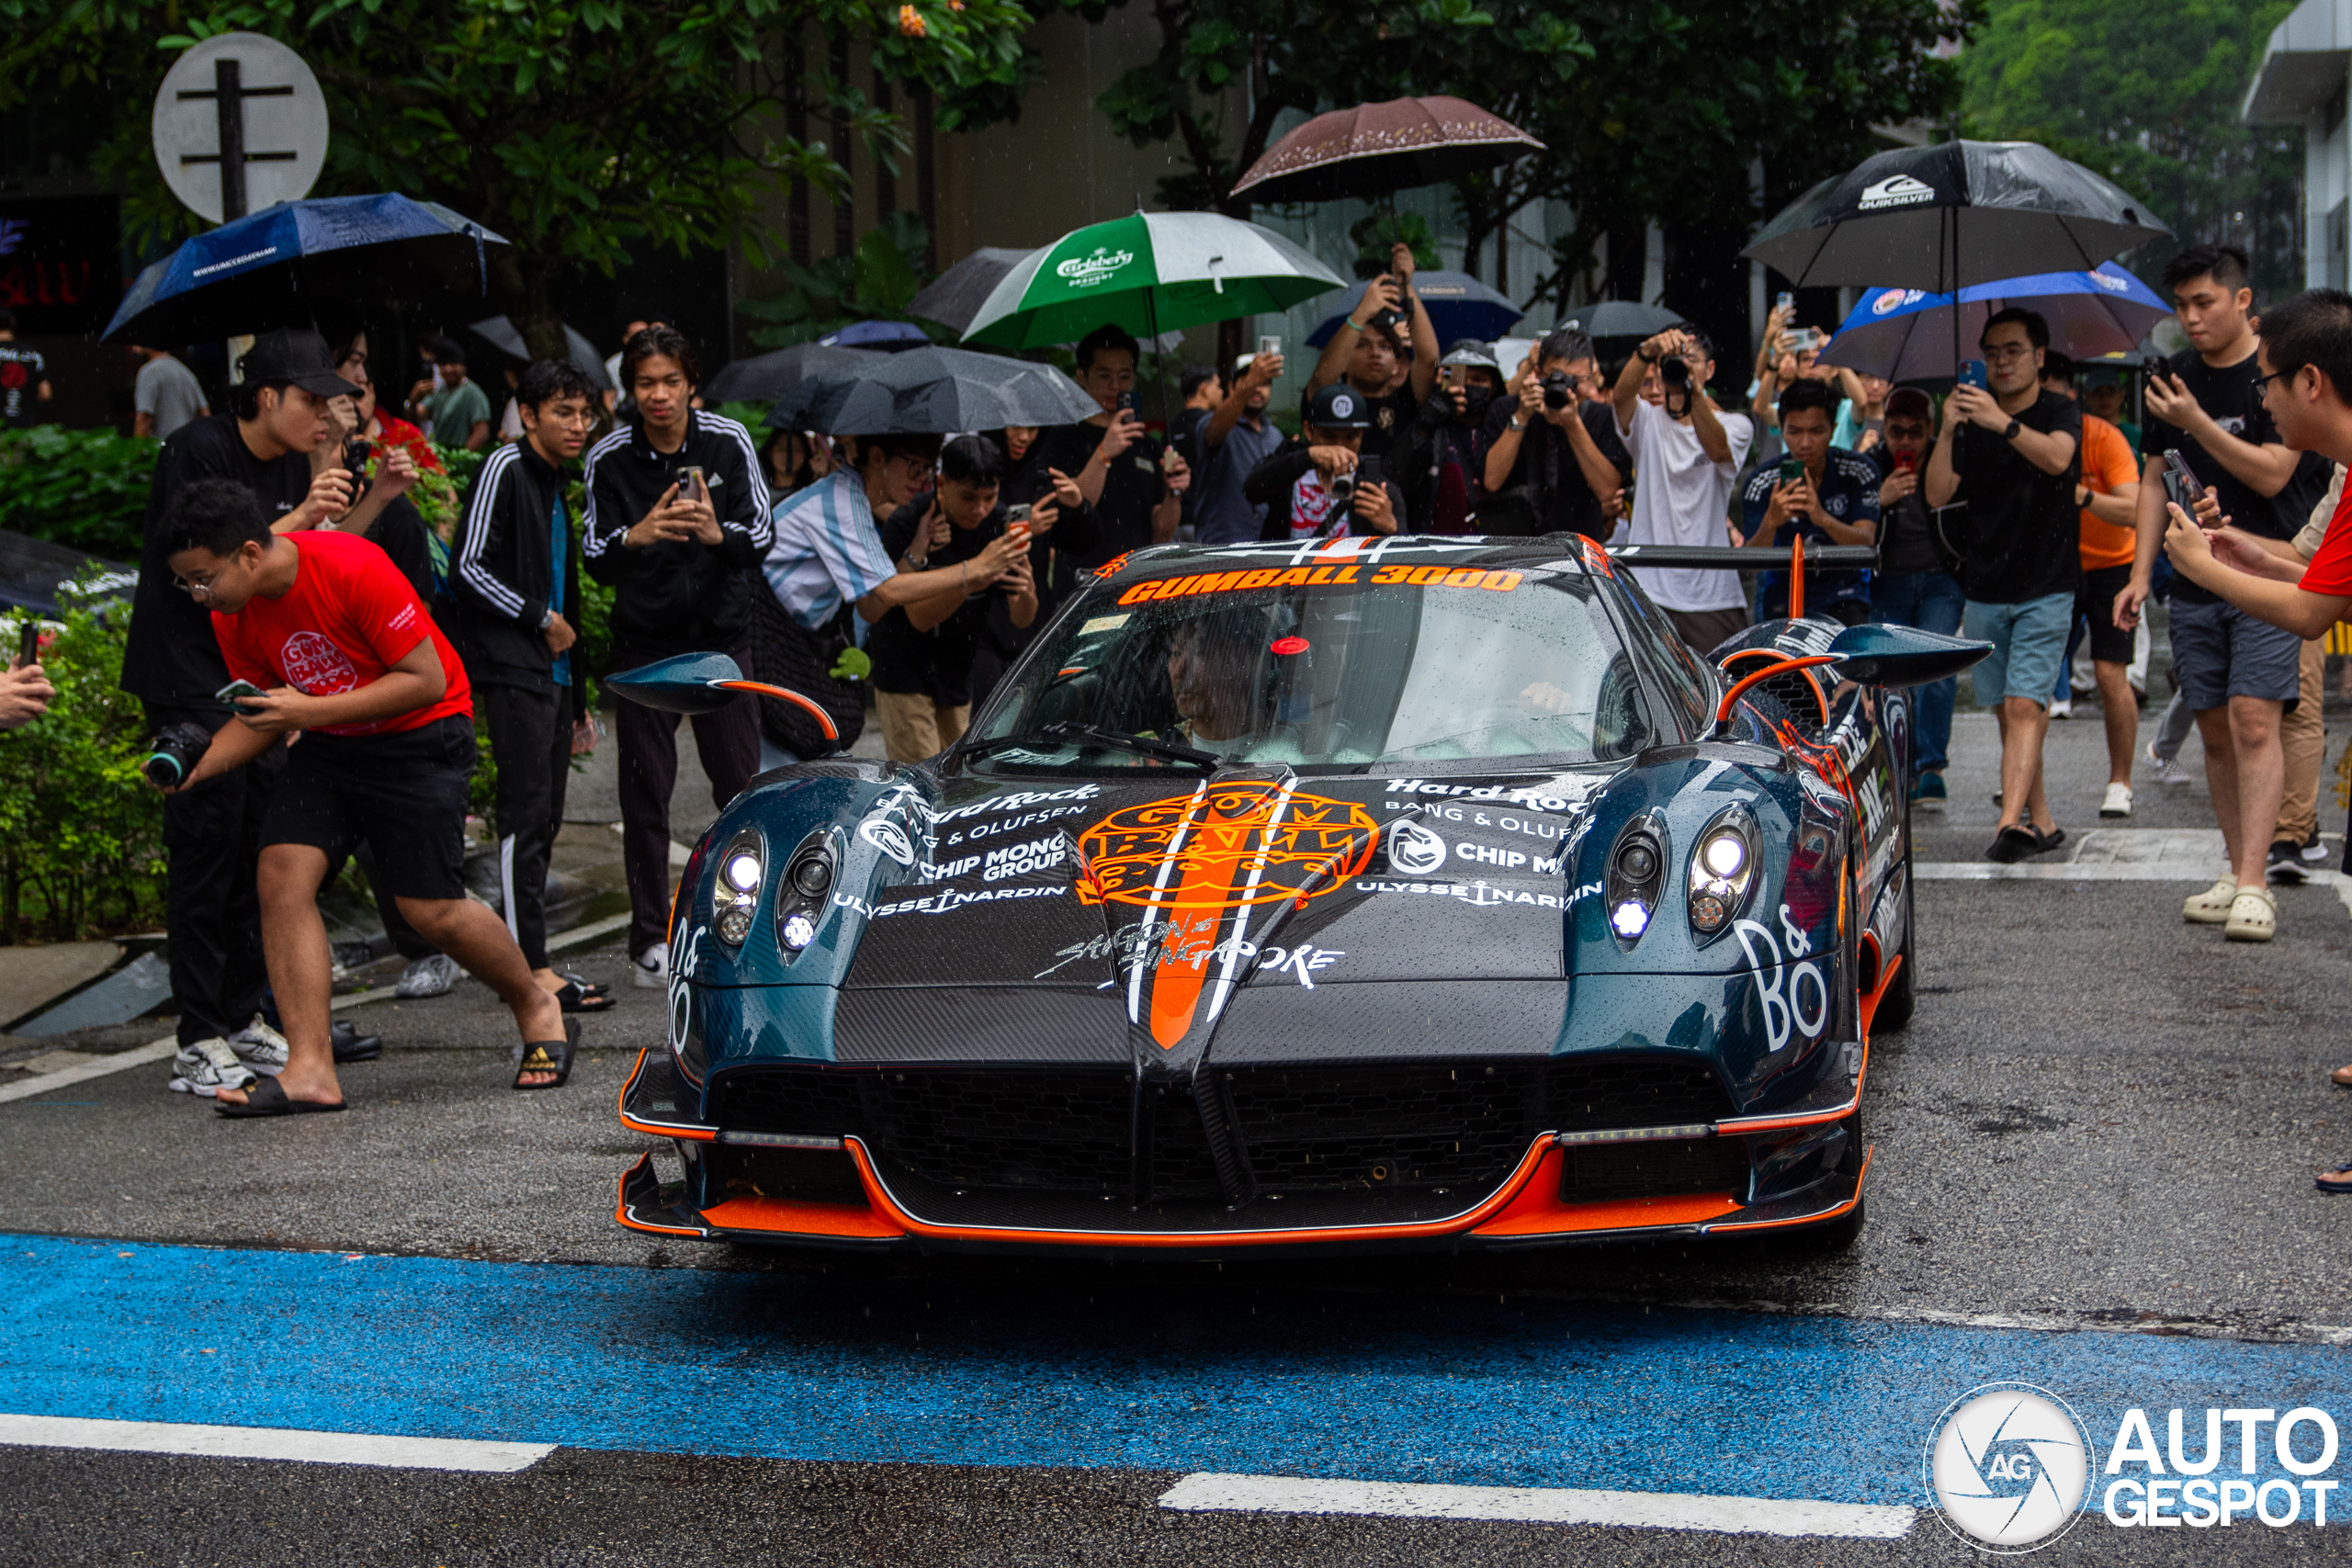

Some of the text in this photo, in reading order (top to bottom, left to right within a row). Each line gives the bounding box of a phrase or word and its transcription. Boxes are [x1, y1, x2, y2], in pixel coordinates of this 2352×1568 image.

[1858, 191, 1935, 210] QUIKSILVER
[1057, 249, 1133, 277] Carlsberg
[1117, 565, 1524, 605] GUMBALL 3000
[283, 633, 336, 663] GUM
[290, 649, 349, 684] BALL
[1385, 778, 1590, 814] Hard Roc
[876, 797, 1088, 849] BANG & OLUFSEN
[1385, 801, 1464, 821] BANG
[1474, 812, 1492, 827] &
[919, 831, 1066, 880] CHIP MONG
[983, 849, 1066, 882] GROUP
[1455, 841, 1527, 868] CHIP
[832, 886, 1068, 919] ULYSSE NARDIN
[1355, 880, 1603, 911] ULYSSE NARDIN
[1035, 913, 1193, 979] SAIGON
[1097, 937, 1346, 989] SINGAPORE
